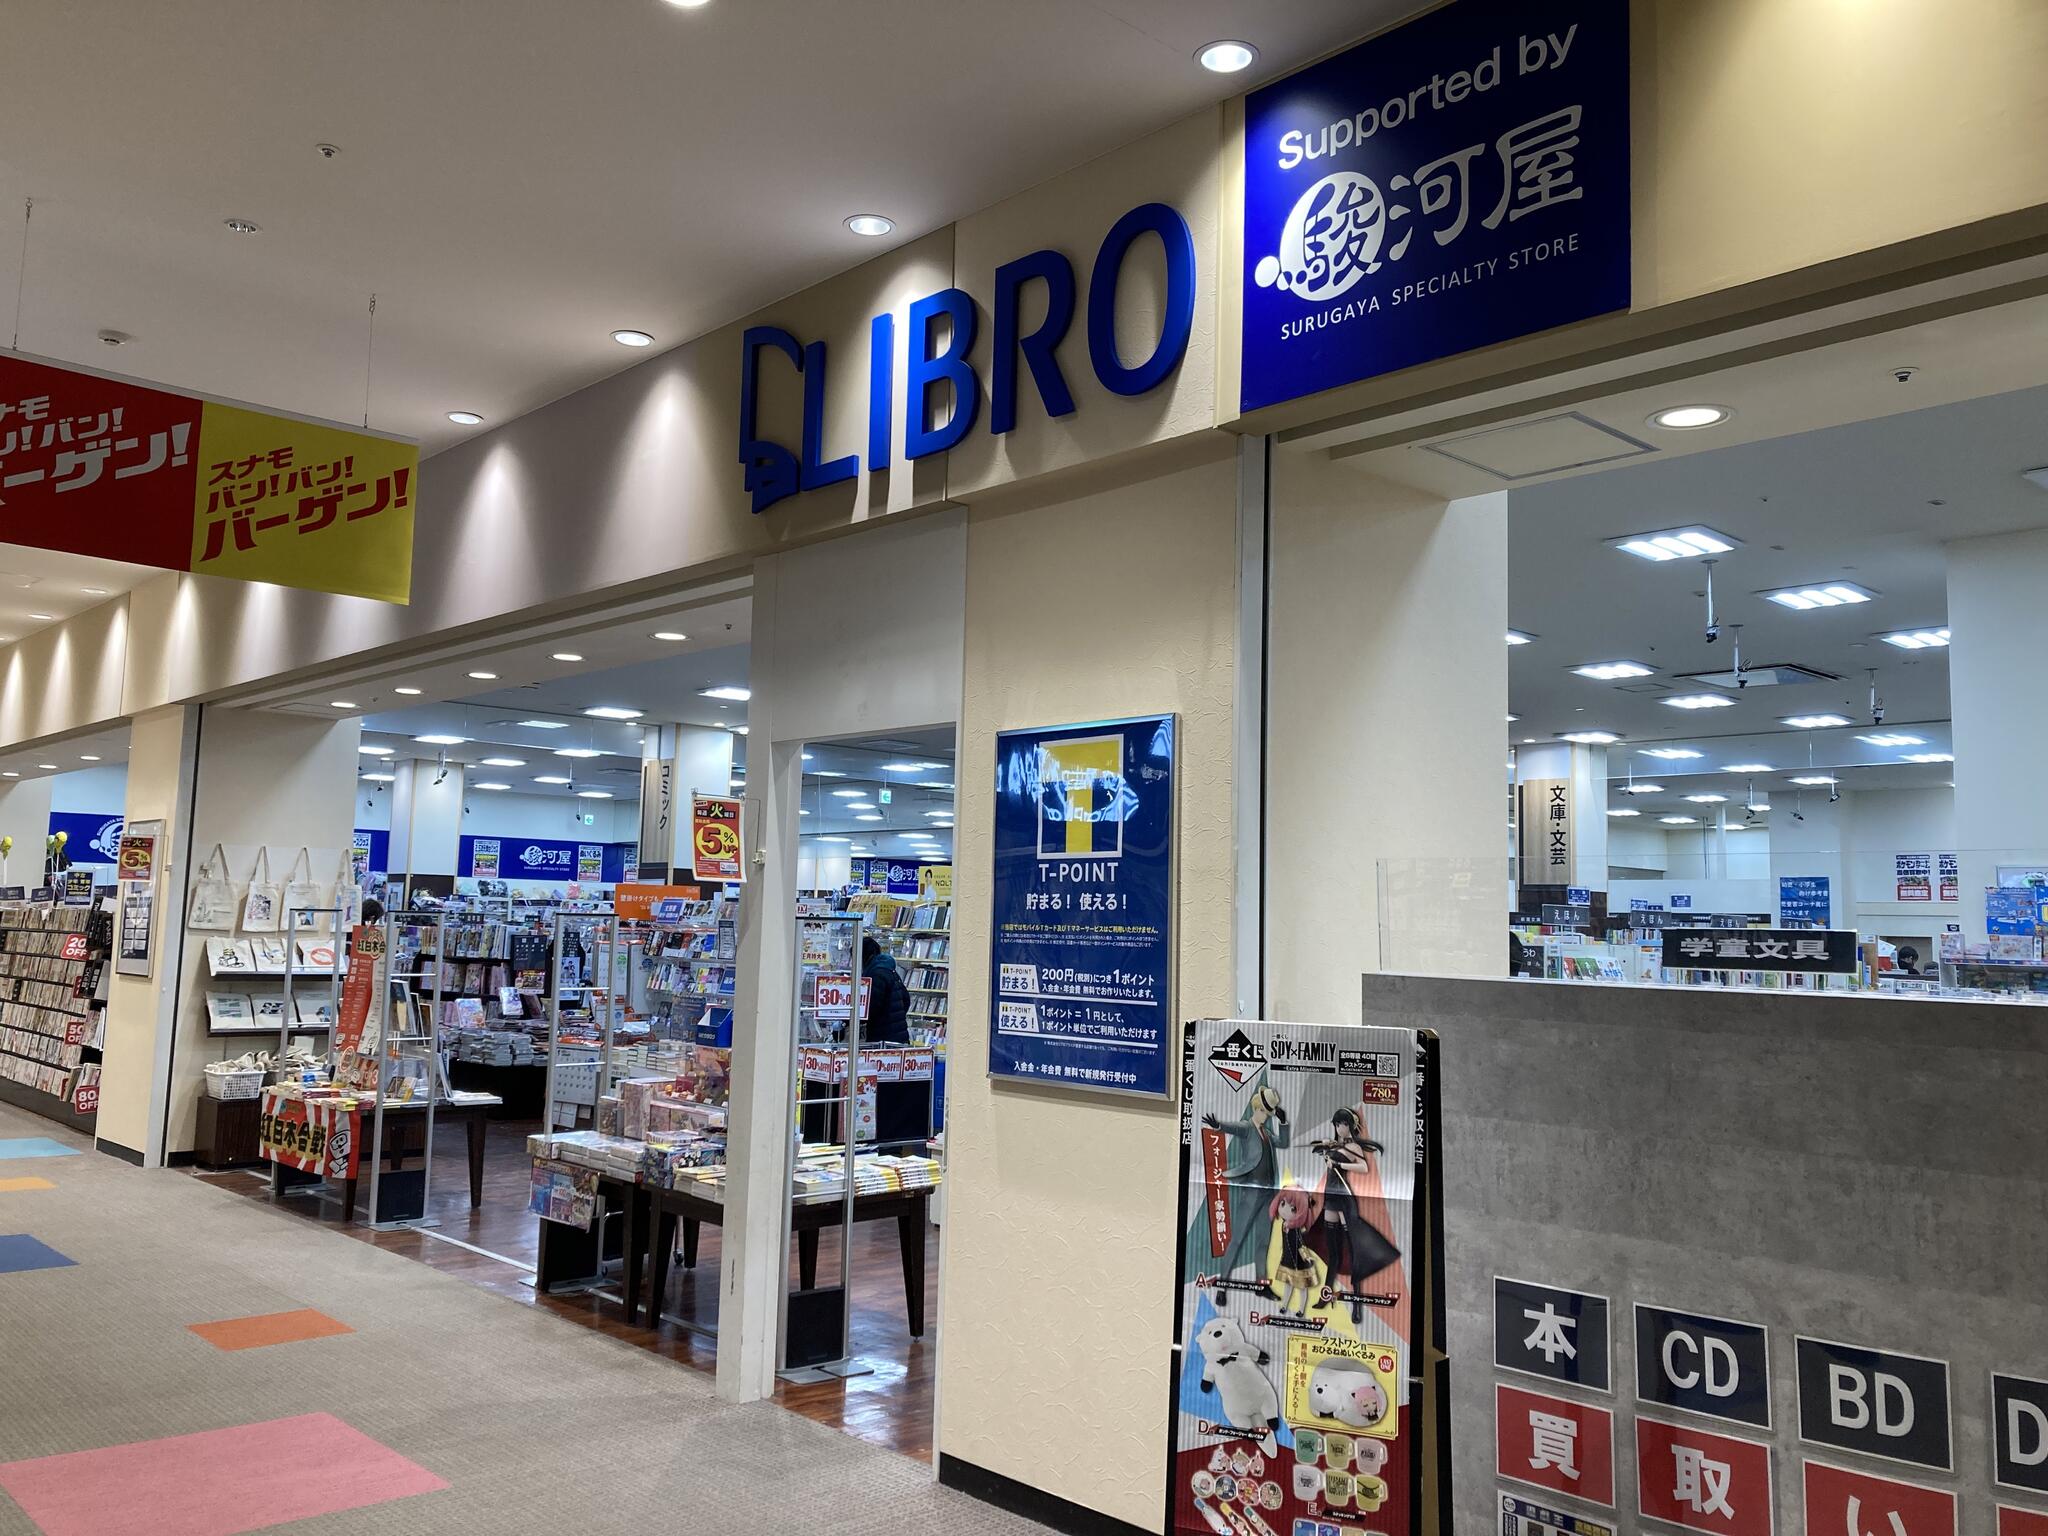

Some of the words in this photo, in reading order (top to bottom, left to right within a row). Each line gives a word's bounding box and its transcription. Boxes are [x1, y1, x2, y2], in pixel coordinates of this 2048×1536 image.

[1278, 46, 1500, 170] Supported
[1519, 24, 1578, 76] by
[1278, 105, 1583, 301] 駿河屋
[1280, 295, 1380, 340] SURUGAYA
[1392, 258, 1499, 306] SPECIALTY
[1508, 233, 1580, 270] STORE
[803, 203, 1197, 492] LIBRO
[208, 446, 293, 486] スナモ
[206, 455, 354, 514] バン!バン!
[199, 467, 410, 562] バーゲン!
[660, 765, 670, 830] コミック
[1550, 785, 1567, 865] 文庫・文芸
[522, 845, 572, 866] 駿河屋
[1038, 862, 1119, 882] T-POINT
[67, 884, 91, 892] コミック
[1026, 893, 1071, 911] 貯まる!
[1079, 893, 1127, 910] 使える!
[1554, 909, 1580, 921] えほん
[1640, 914, 1664, 924] えほん
[66, 947, 87, 957] OFF
[68, 937, 87, 948] 20
[1680, 937, 1831, 961] 学童文具
[1001, 976, 1035, 991] 貯まる!
[1001, 1014, 1035, 1029] 使える!
[1212, 1043, 1265, 1059] 一番くじ
[1014, 1061, 1061, 1076] 入会金・年会費
[1064, 1066, 1137, 1085] 無料で新規発行受付中
[78, 1090, 97, 1101] 80
[1523, 1303, 1577, 1363] 本
[1311, 1345, 1376, 1360] おひるねぬいぐるみ
[1662, 1330, 1740, 1398] CD
[1828, 1362, 1916, 1438] BD
[1529, 1409, 1581, 1480] 買
[1671, 1443, 1735, 1521] 取
